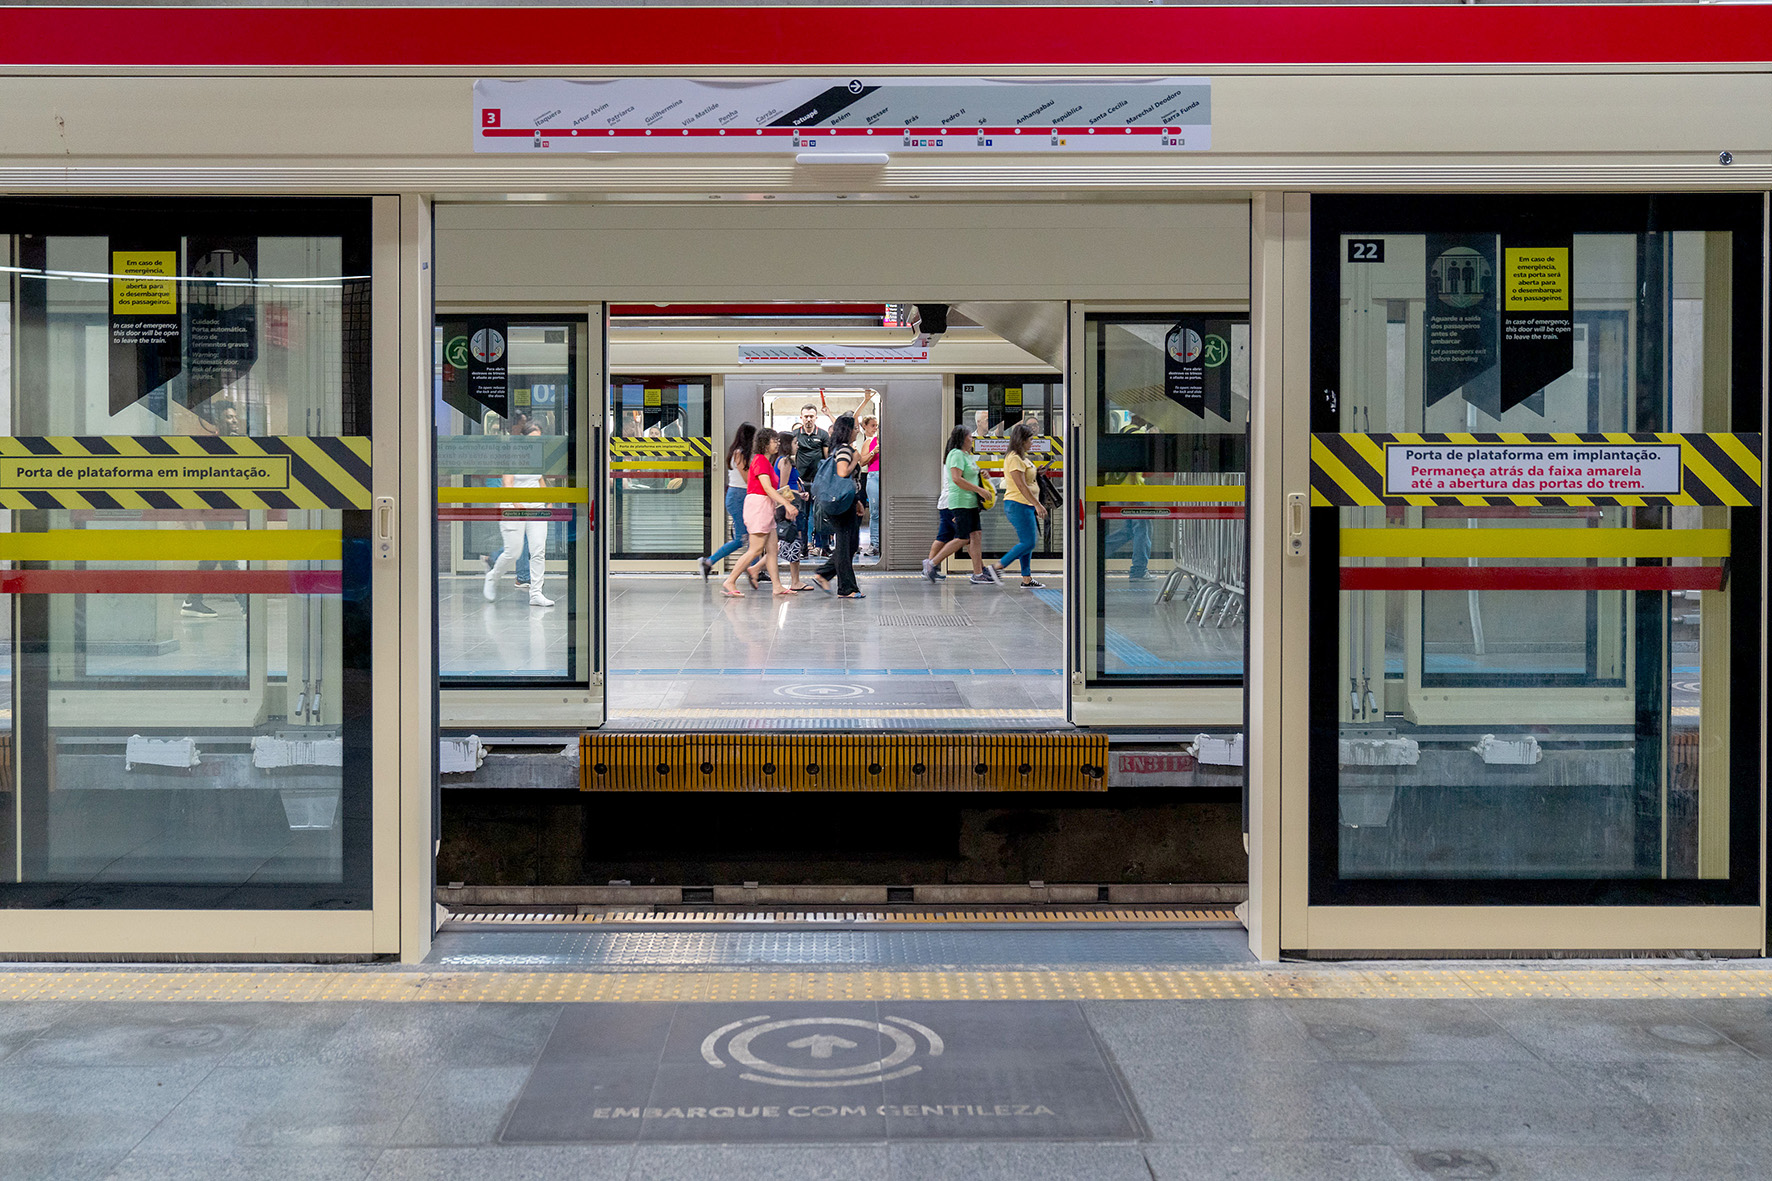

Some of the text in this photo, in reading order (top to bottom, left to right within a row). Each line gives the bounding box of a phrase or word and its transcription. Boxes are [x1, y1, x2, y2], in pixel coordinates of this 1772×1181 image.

[572, 102, 609, 127] Artur Alvim
[644, 99, 683, 124] Guilhermina
[681, 102, 719, 127] Vila Matilde
[866, 106, 889, 123] Bresser
[1016, 99, 1055, 125] Anhangabaú
[1052, 104, 1083, 125] República
[1126, 104, 1154, 124] Marechal
[1154, 90, 1182, 108] Deodoro
[1162, 112, 1180, 124] Barra
[1180, 100, 1200, 115] Funda
[487, 112, 496, 124] 3
[535, 109, 562, 127] Itaquera
[606, 106, 635, 124] Patriarca
[718, 108, 738, 124] Penha
[755, 108, 777, 123] Carrão
[792, 108, 819, 126] Tatuapé
[830, 111, 851, 126] Belém
[904, 114, 919, 126] Brás
[941, 110, 961, 125] Pedro
[978, 117, 987, 126] Sé
[1088, 112, 1106, 125] Santa
[1354, 243, 1378, 258] 22
[1406, 450, 1442, 460] Porta
[1446, 450, 1463, 460] de
[1467, 449, 1543, 462] plataforma
[1573, 449, 1661, 462] implantação.
[17, 467, 270, 480] Porta de plataforma em implantação.
[1411, 465, 1641, 479] Permaneça atrás da faixa amarela
[1411, 478, 1432, 488] até
[1449, 478, 1508, 488] abertura
[1512, 478, 1535, 488] das
[1540, 479, 1582, 490] portas
[1587, 478, 1604, 488] do
[1609, 479, 1644, 488] trem.
[1120, 757, 1193, 771] RN3112
[592, 1105, 1055, 1118] EMBARQUE COM GENTILEZA
